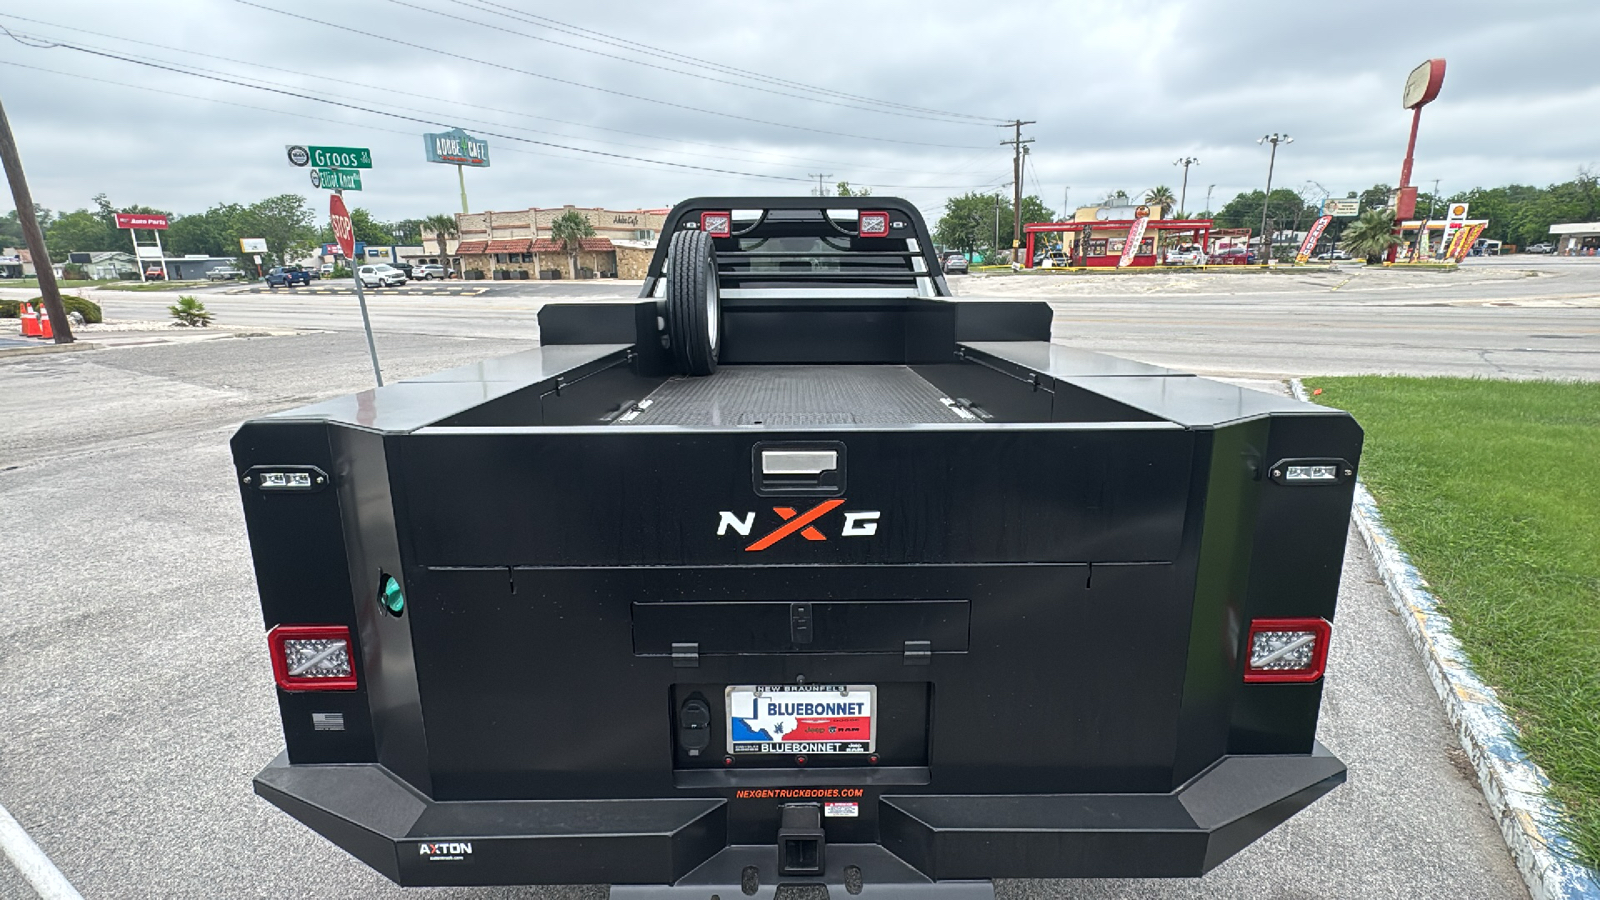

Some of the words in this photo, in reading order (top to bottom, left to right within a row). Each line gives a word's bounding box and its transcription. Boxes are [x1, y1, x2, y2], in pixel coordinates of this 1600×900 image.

[436, 138, 462, 156] ADOBE
[468, 141, 487, 160] CAFE
[315, 150, 358, 166] Groos
[320, 171, 339, 188] Elliot
[338, 172, 355, 188] Knox
[613, 215, 627, 224] Adobe
[332, 214, 351, 241] STOP
[1303, 217, 1328, 255] MENUDO
[768, 702, 864, 716] BLUEBONNET
[761, 743, 842, 752] BLUEBONNET
[736, 788, 863, 799] NEXGENTRUCKBODIES.COM
[420, 843, 472, 854] AXTON
